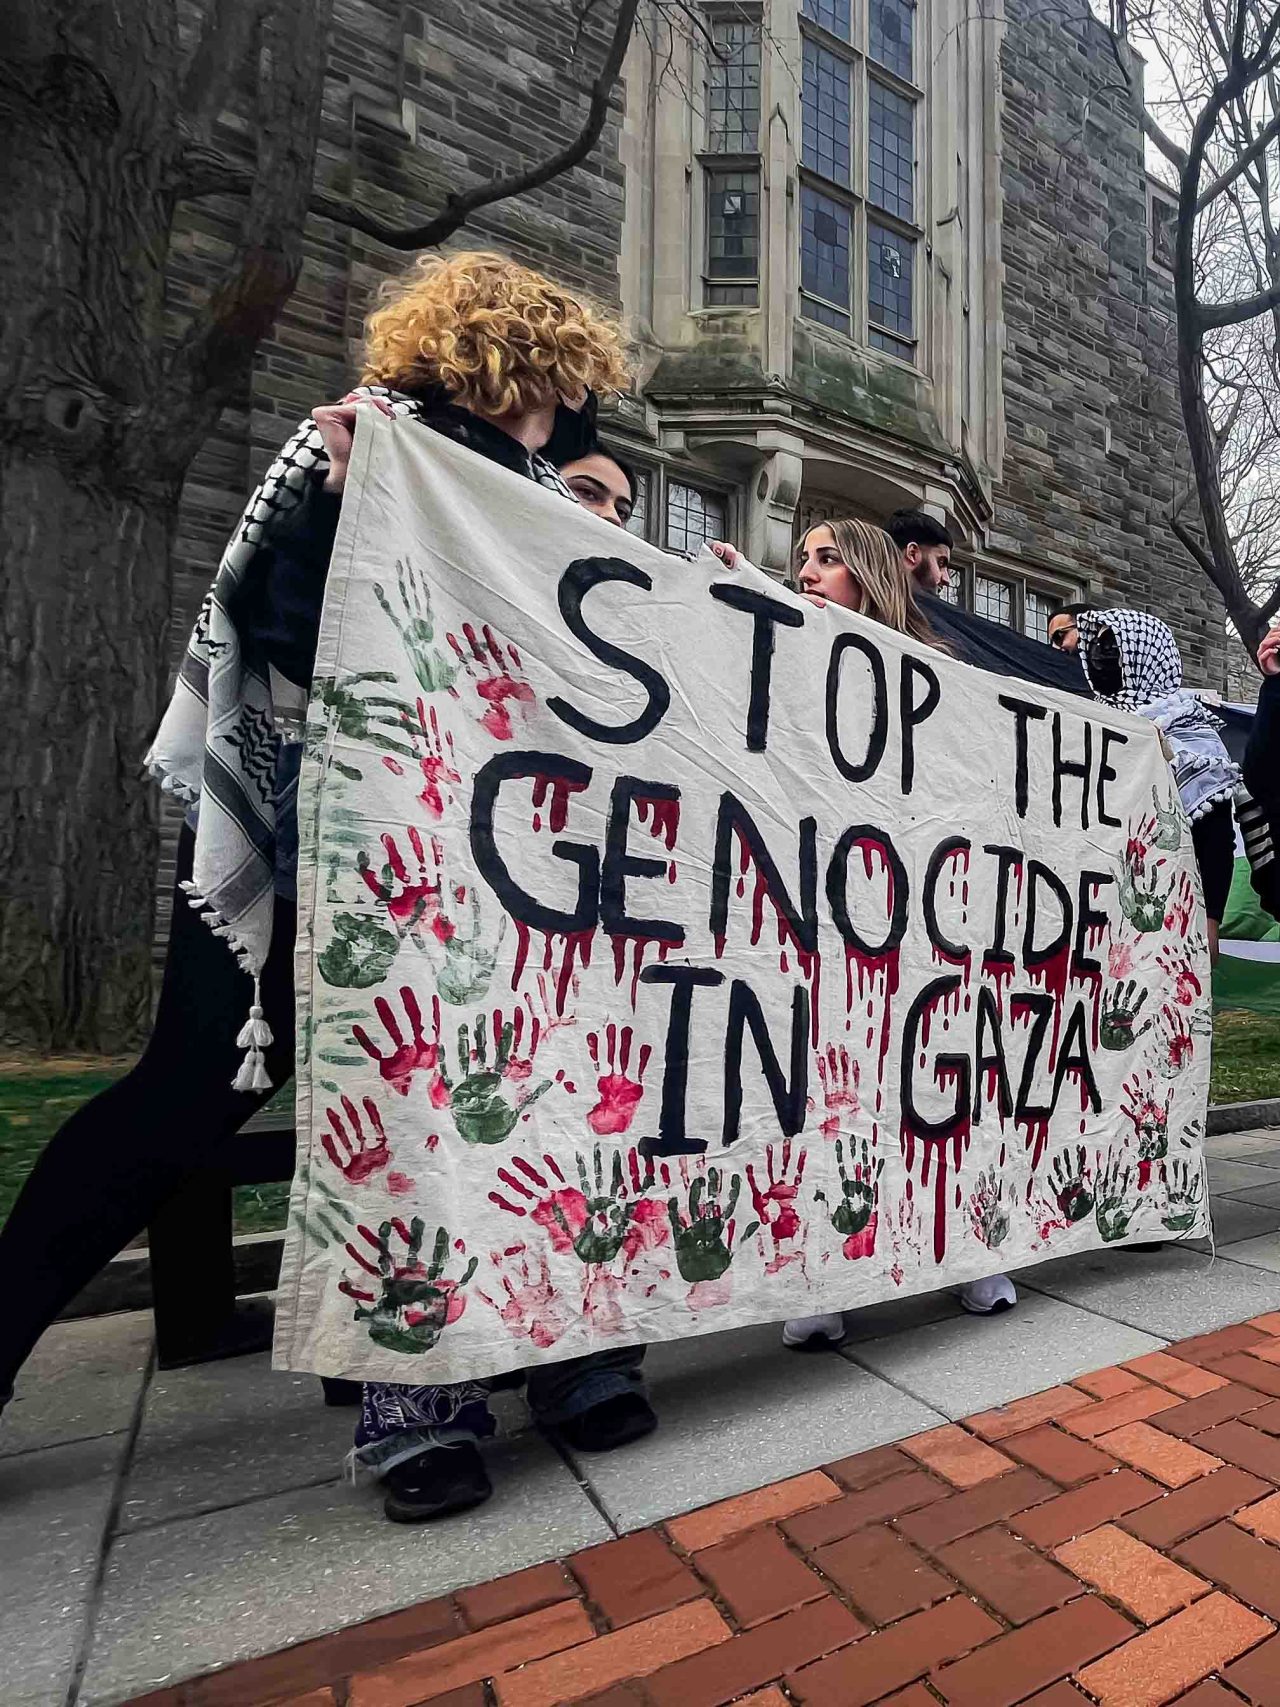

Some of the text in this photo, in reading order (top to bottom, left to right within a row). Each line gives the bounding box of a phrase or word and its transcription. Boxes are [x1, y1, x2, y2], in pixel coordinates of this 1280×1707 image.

[547, 556, 1129, 830] STOP THE
[470, 750, 1114, 978] GENOCIDE
[637, 964, 1102, 1158] IN GAZA
